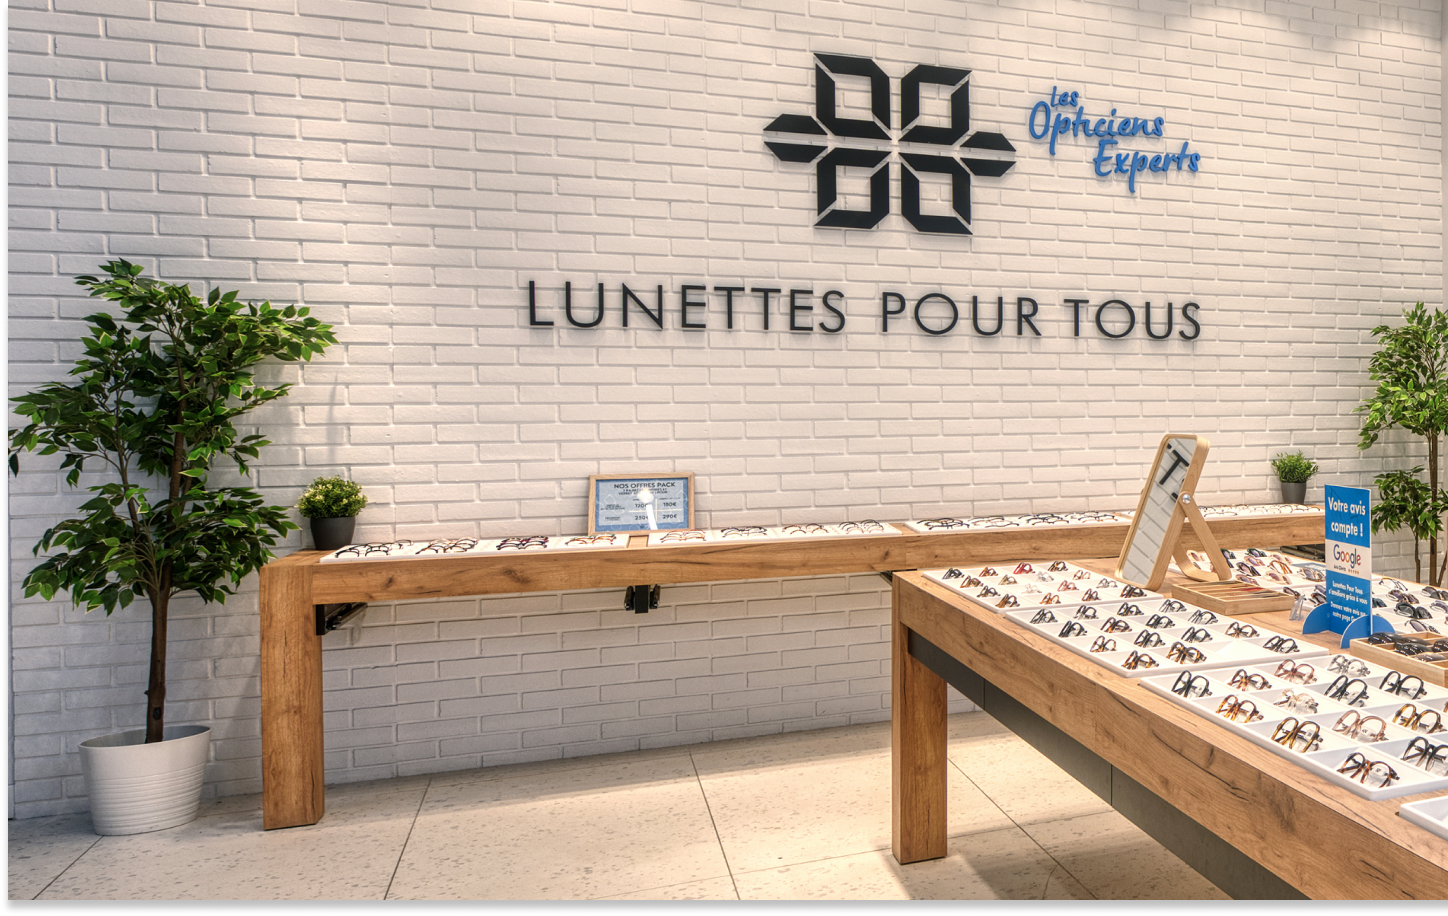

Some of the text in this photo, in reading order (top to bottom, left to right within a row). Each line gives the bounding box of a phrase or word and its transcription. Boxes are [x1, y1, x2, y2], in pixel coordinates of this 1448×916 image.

[1050, 85, 1079, 108] Les
[1028, 101, 1165, 156] Opticiens
[1093, 138, 1201, 194] Experts
[528, 280, 1202, 341] LUNETTES POUR TOUS
[1328, 496, 1366, 516] Votre avis
[1331, 522, 1358, 538] compte
[1333, 544, 1361, 568] Google
[1333, 581, 1346, 590] Lunettes
[1355, 586, 1363, 594] Tous
